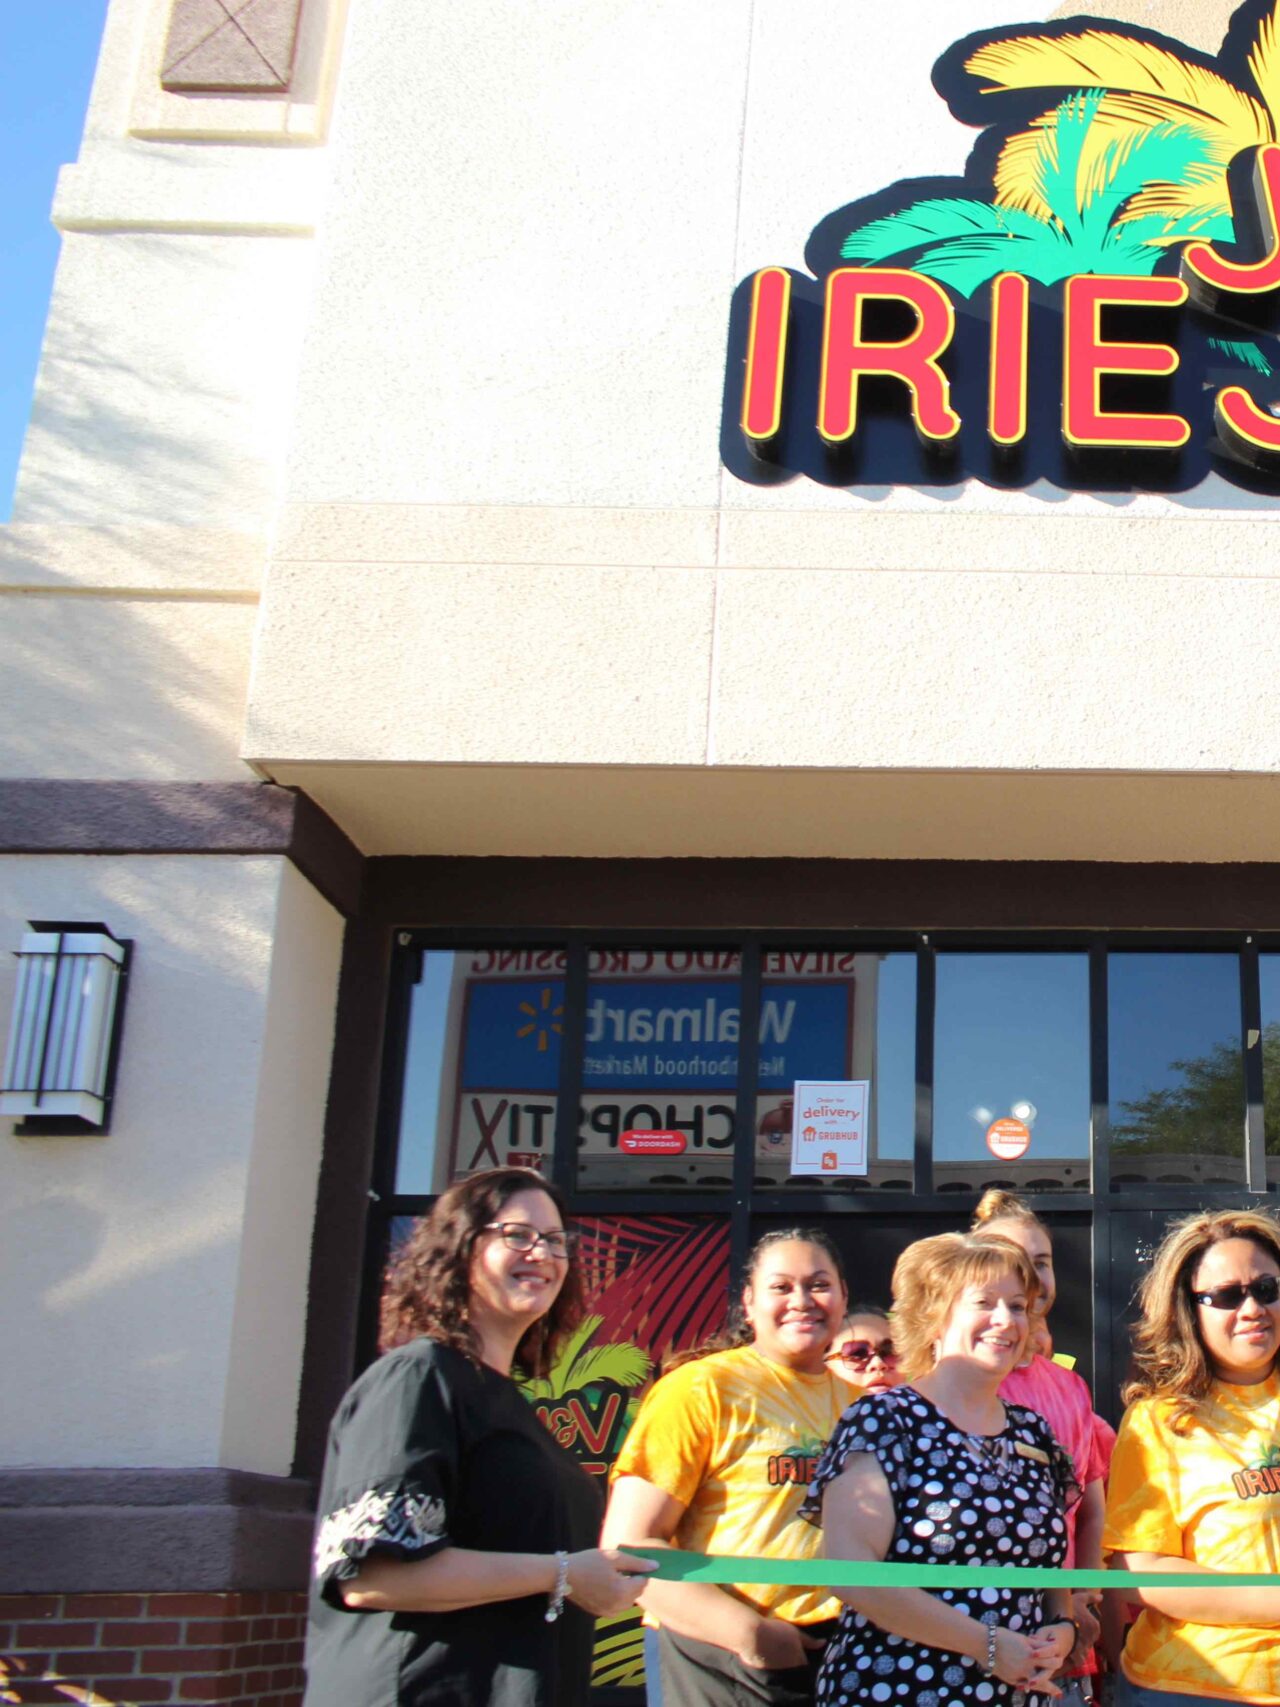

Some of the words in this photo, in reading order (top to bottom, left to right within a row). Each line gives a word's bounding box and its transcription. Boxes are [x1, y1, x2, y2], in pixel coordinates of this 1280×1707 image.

[740, 266, 1193, 450] IRIE
[803, 1105, 860, 1121] delivery
[818, 1131, 859, 1141] GRUBHUB
